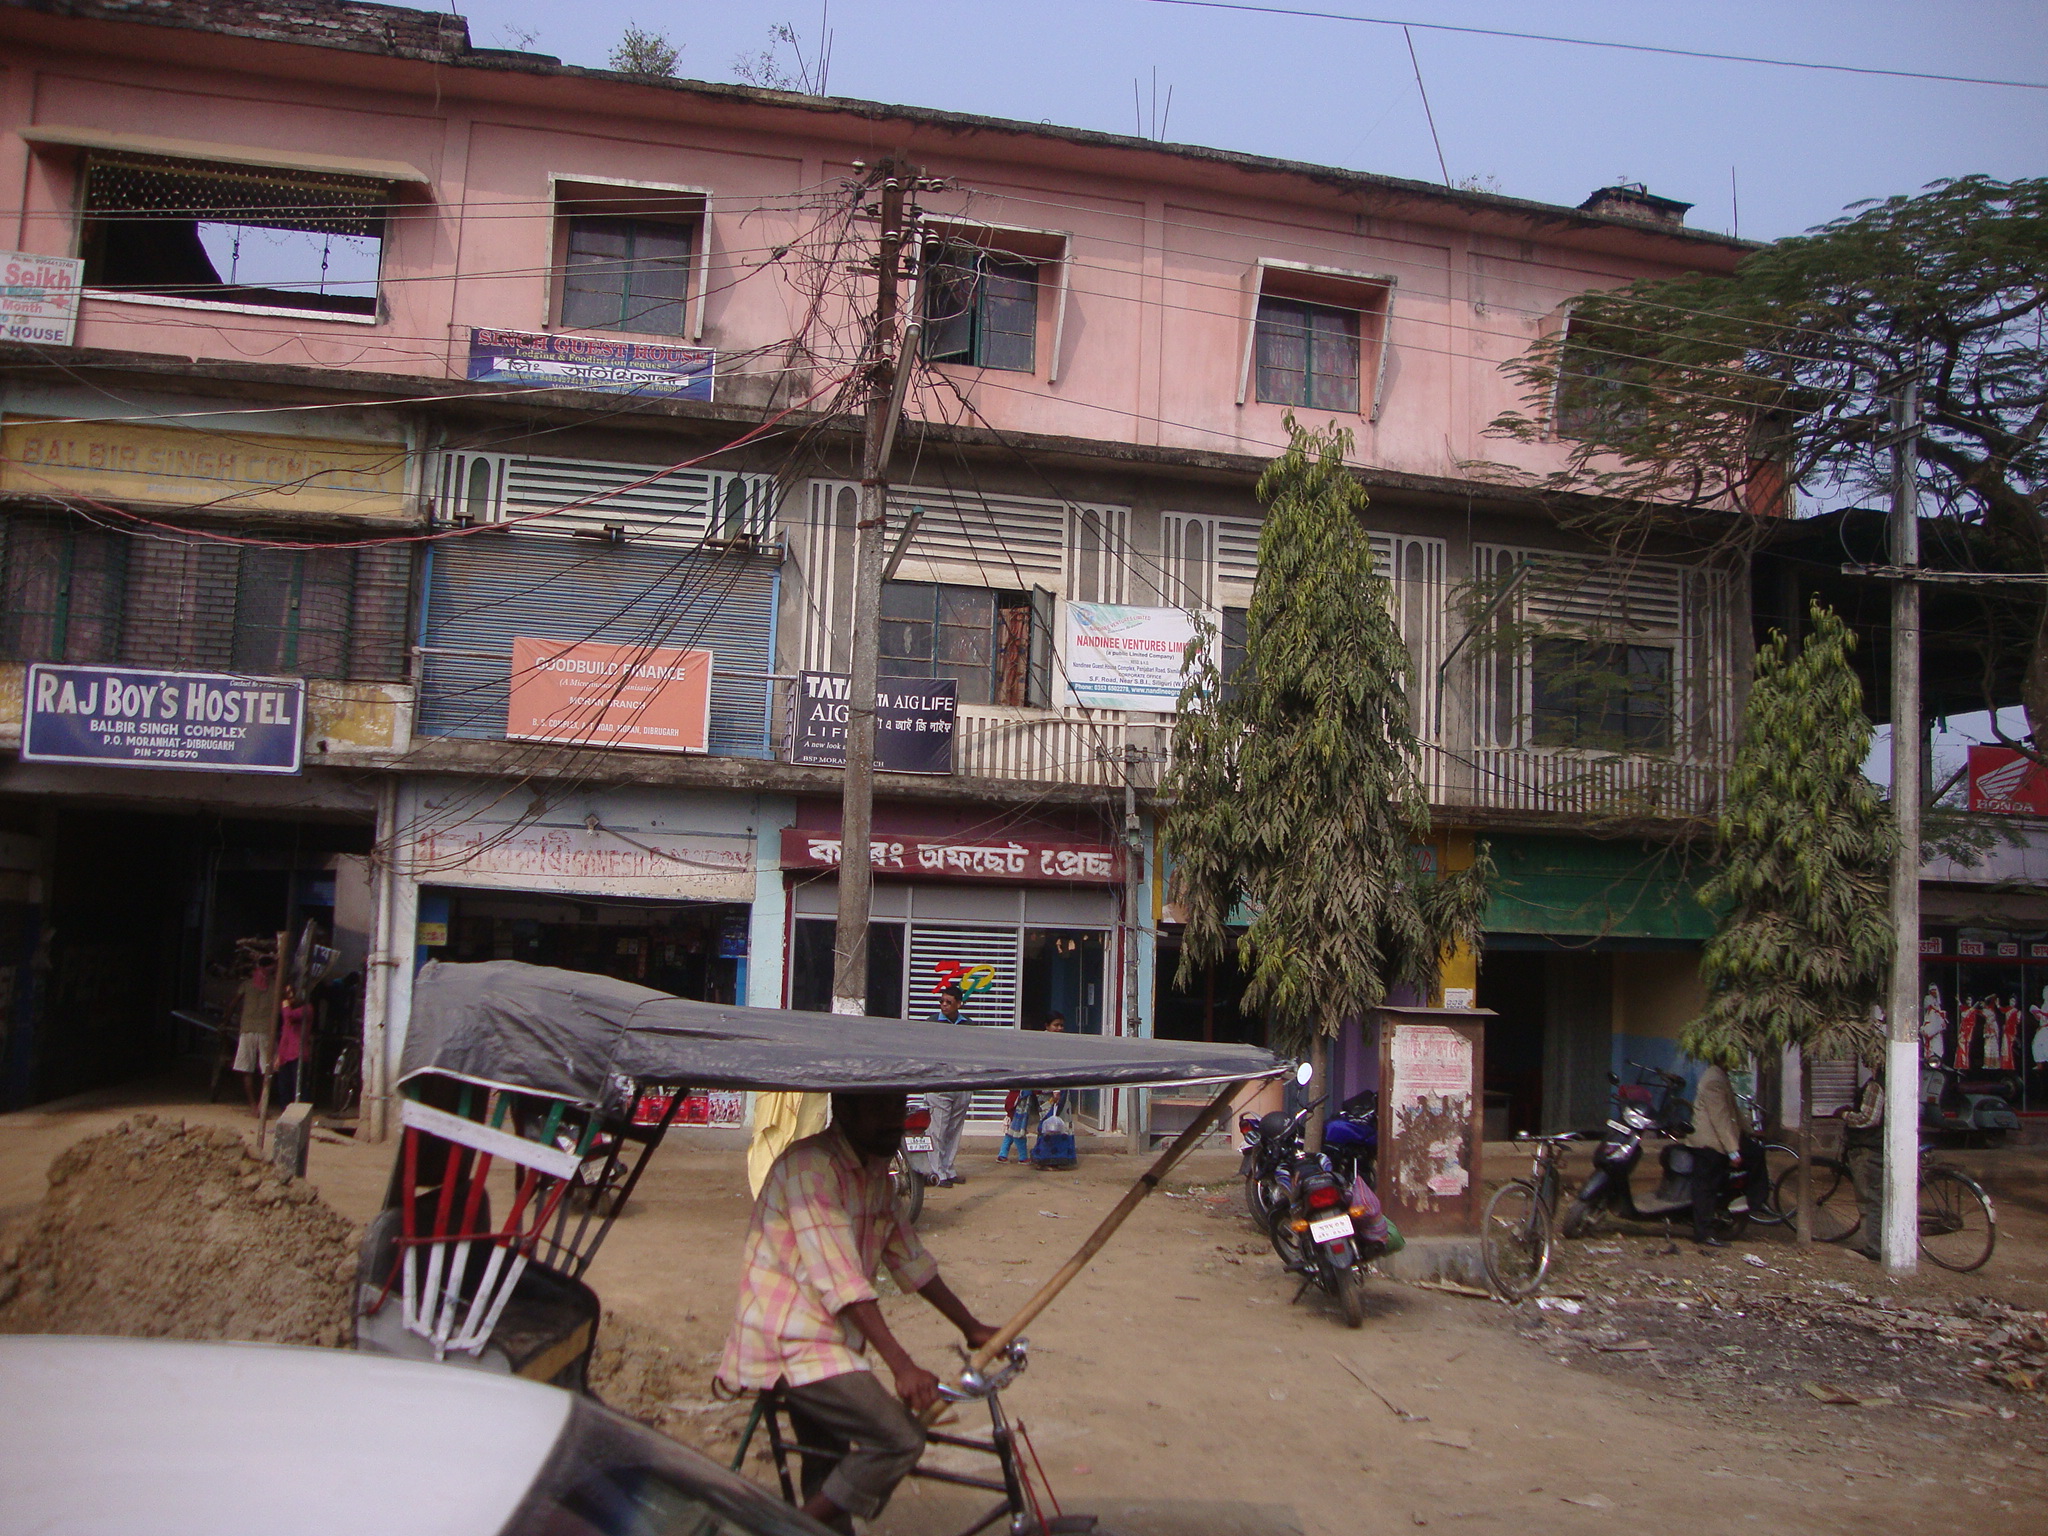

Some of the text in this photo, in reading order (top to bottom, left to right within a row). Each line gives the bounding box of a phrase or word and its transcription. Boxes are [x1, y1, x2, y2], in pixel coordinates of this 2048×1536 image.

[5, 263, 71, 292] Seikh
[10, 325, 64, 341] HOUSE
[478, 330, 708, 365] SINGH GUEST HOUSE
[516, 349, 554, 361] Lodging
[569, 355, 608, 366] Fooding
[611, 358, 626, 367] (on
[629, 360, 669, 370] request)
[23, 437, 390, 492] BALBIR SINGH COMPLEX
[1076, 635, 1120, 649] NANDINEE
[1122, 639, 1166, 653] VENTURES
[535, 656, 686, 681] GOODBUILD FINANCE
[560, 678, 660, 693] (A Microfinance Oganisation)
[1152, 680, 1172, 688] Siliguri
[36, 673, 291, 725] RAJ BOY'S HOSTEL
[570, 696, 646, 709] MORAN BRANCH
[894, 695, 919, 710] AIG
[922, 696, 953, 711] LIFE
[810, 703, 849, 723] AIG
[90, 720, 247, 739] BALBIR SINGH COMPLEX
[549, 719, 580, 730] COMPLEX,
[643, 727, 680, 737] DIBRUGARH
[807, 726, 848, 738] LIF
[103, 735, 122, 746] P.O.
[827, 741, 841, 750] look
[134, 748, 199, 759] PIN-785670
[1976, 799, 2035, 813] HONDA
